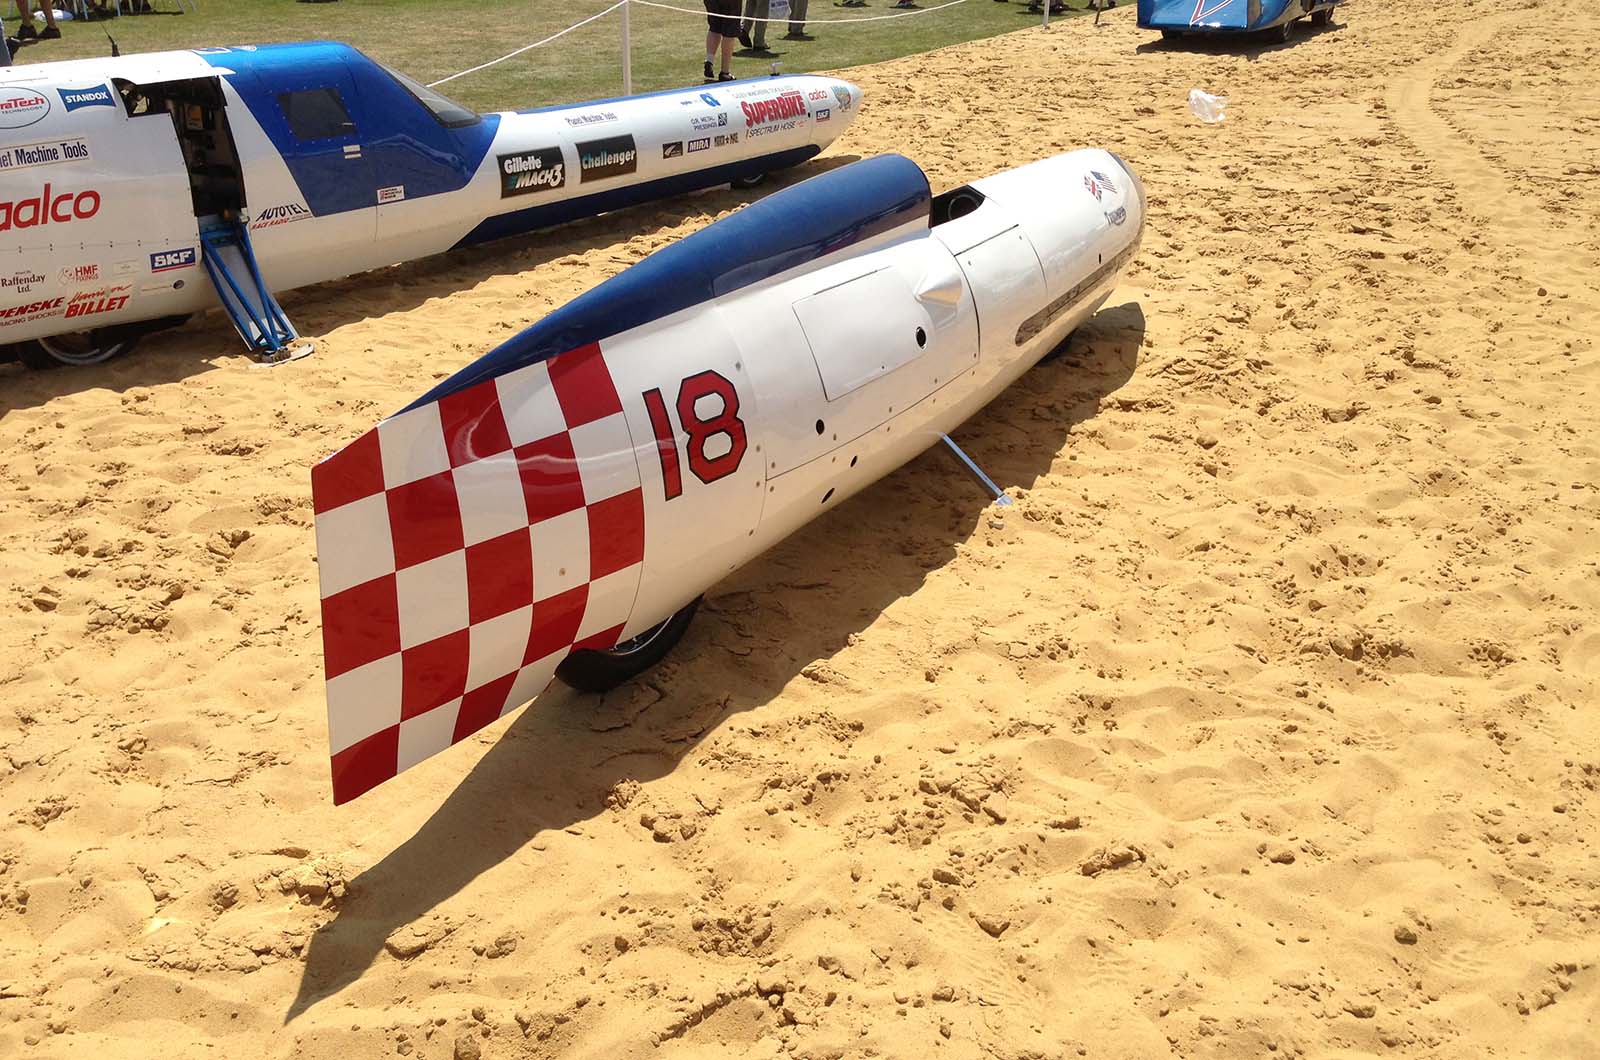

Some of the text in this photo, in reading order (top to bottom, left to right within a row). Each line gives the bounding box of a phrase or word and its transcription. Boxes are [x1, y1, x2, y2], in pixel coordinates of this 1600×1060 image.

[65, 91, 109, 104] STANDOX
[748, 125, 780, 138] SPECTRUM
[780, 121, 796, 131] HOSE
[15, 145, 59, 166] Machine
[60, 141, 88, 160] Tools
[689, 138, 710, 152] MIRA
[503, 155, 543, 175] Gillette
[582, 149, 636, 170] Challenger
[515, 163, 563, 188] MACH3
[255, 202, 310, 222] AUTOTEL
[154, 250, 193, 268] SKF
[75, 264, 98, 277] HMF
[64, 295, 130, 319] BILLET
[641, 369, 748, 502] 18
